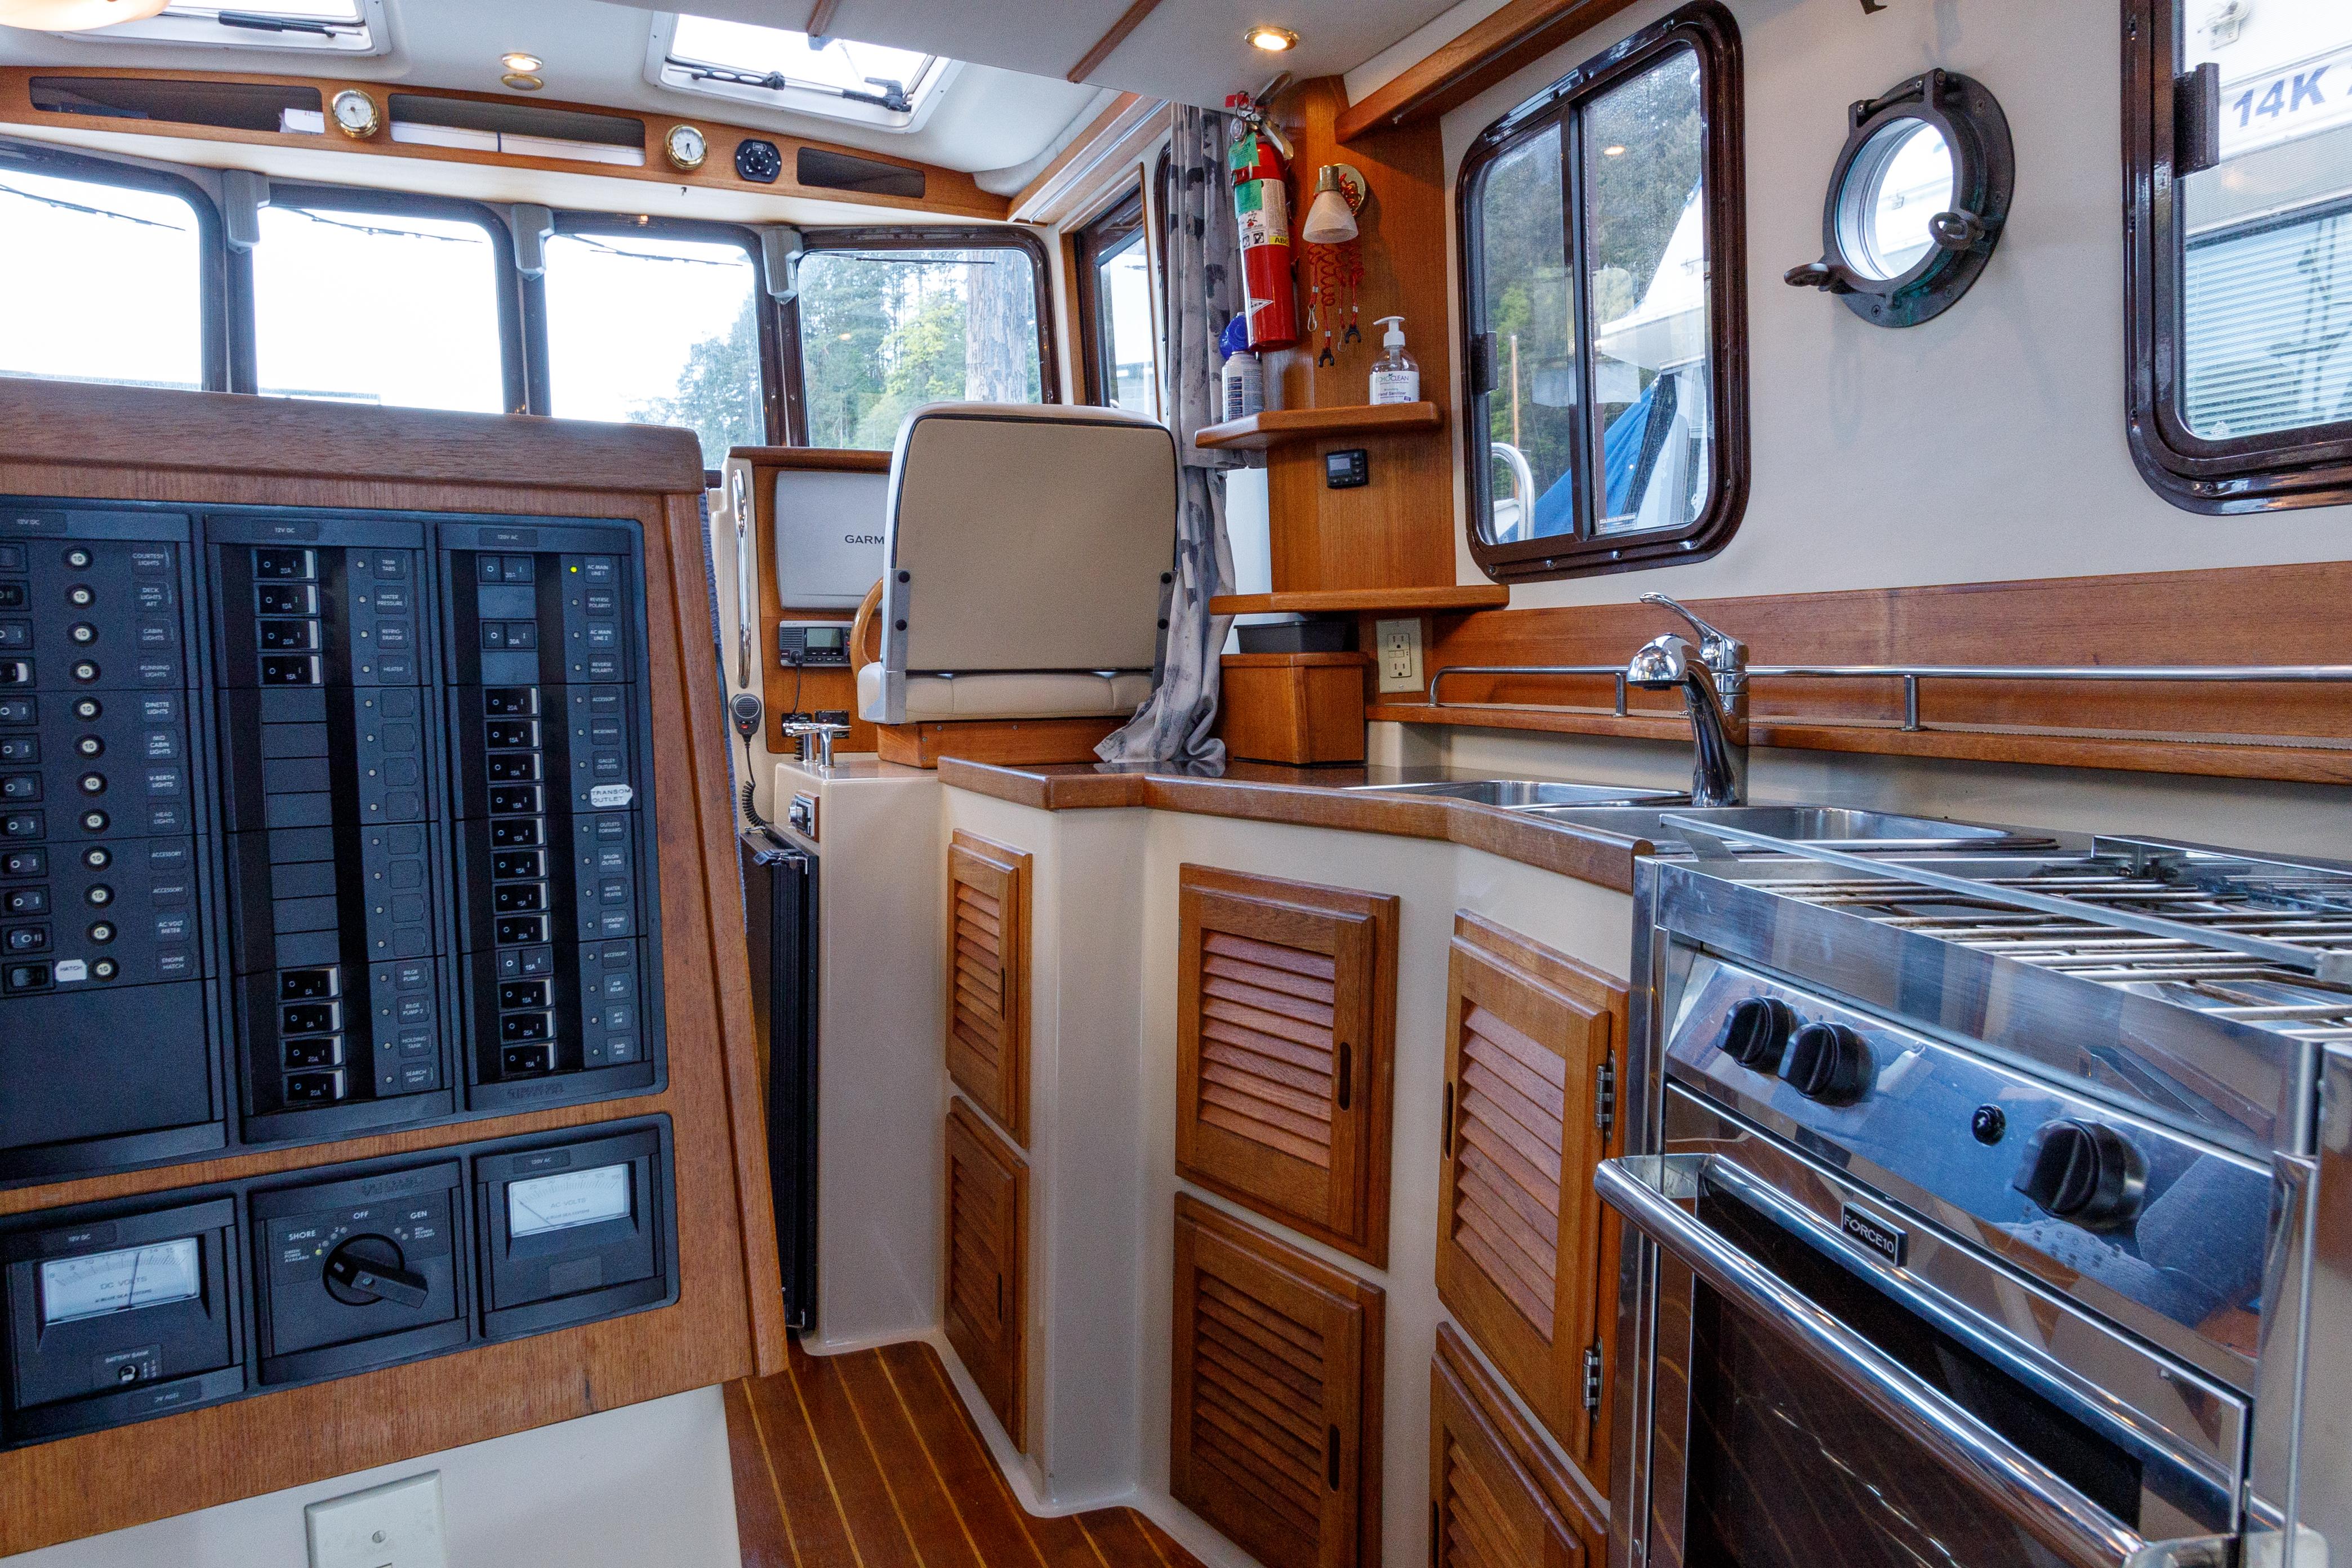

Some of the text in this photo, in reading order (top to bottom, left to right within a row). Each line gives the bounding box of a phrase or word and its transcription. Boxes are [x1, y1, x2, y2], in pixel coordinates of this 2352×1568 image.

[2233, 65, 2332, 128] 14K
[564, 1197, 586, 1206] VOLTS
[353, 1211, 368, 1219] OFF
[410, 1211, 427, 1219] GEN
[288, 1230, 316, 1241] SHORE
